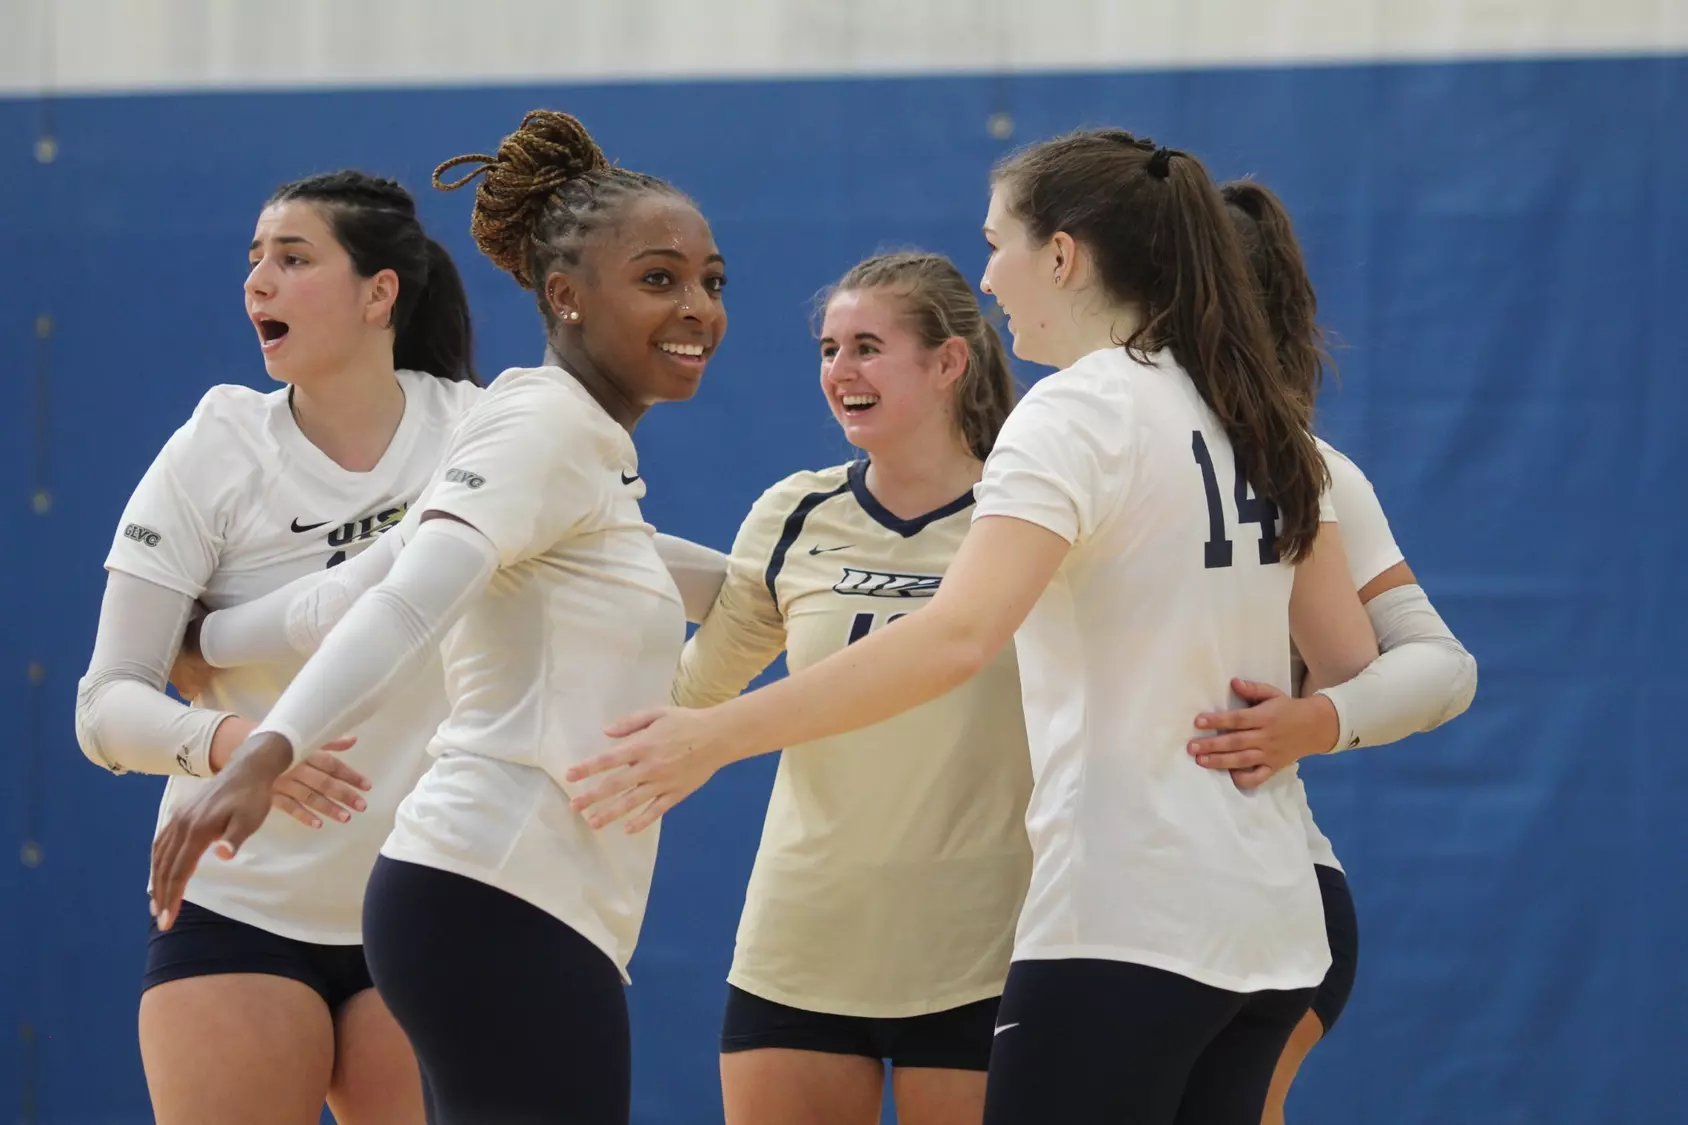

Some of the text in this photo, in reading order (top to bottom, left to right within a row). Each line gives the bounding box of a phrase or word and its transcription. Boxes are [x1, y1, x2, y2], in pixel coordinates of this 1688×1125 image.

[1192, 430, 1281, 569] 14
[124, 523, 161, 547] GLVC
[848, 613, 908, 646] 1
